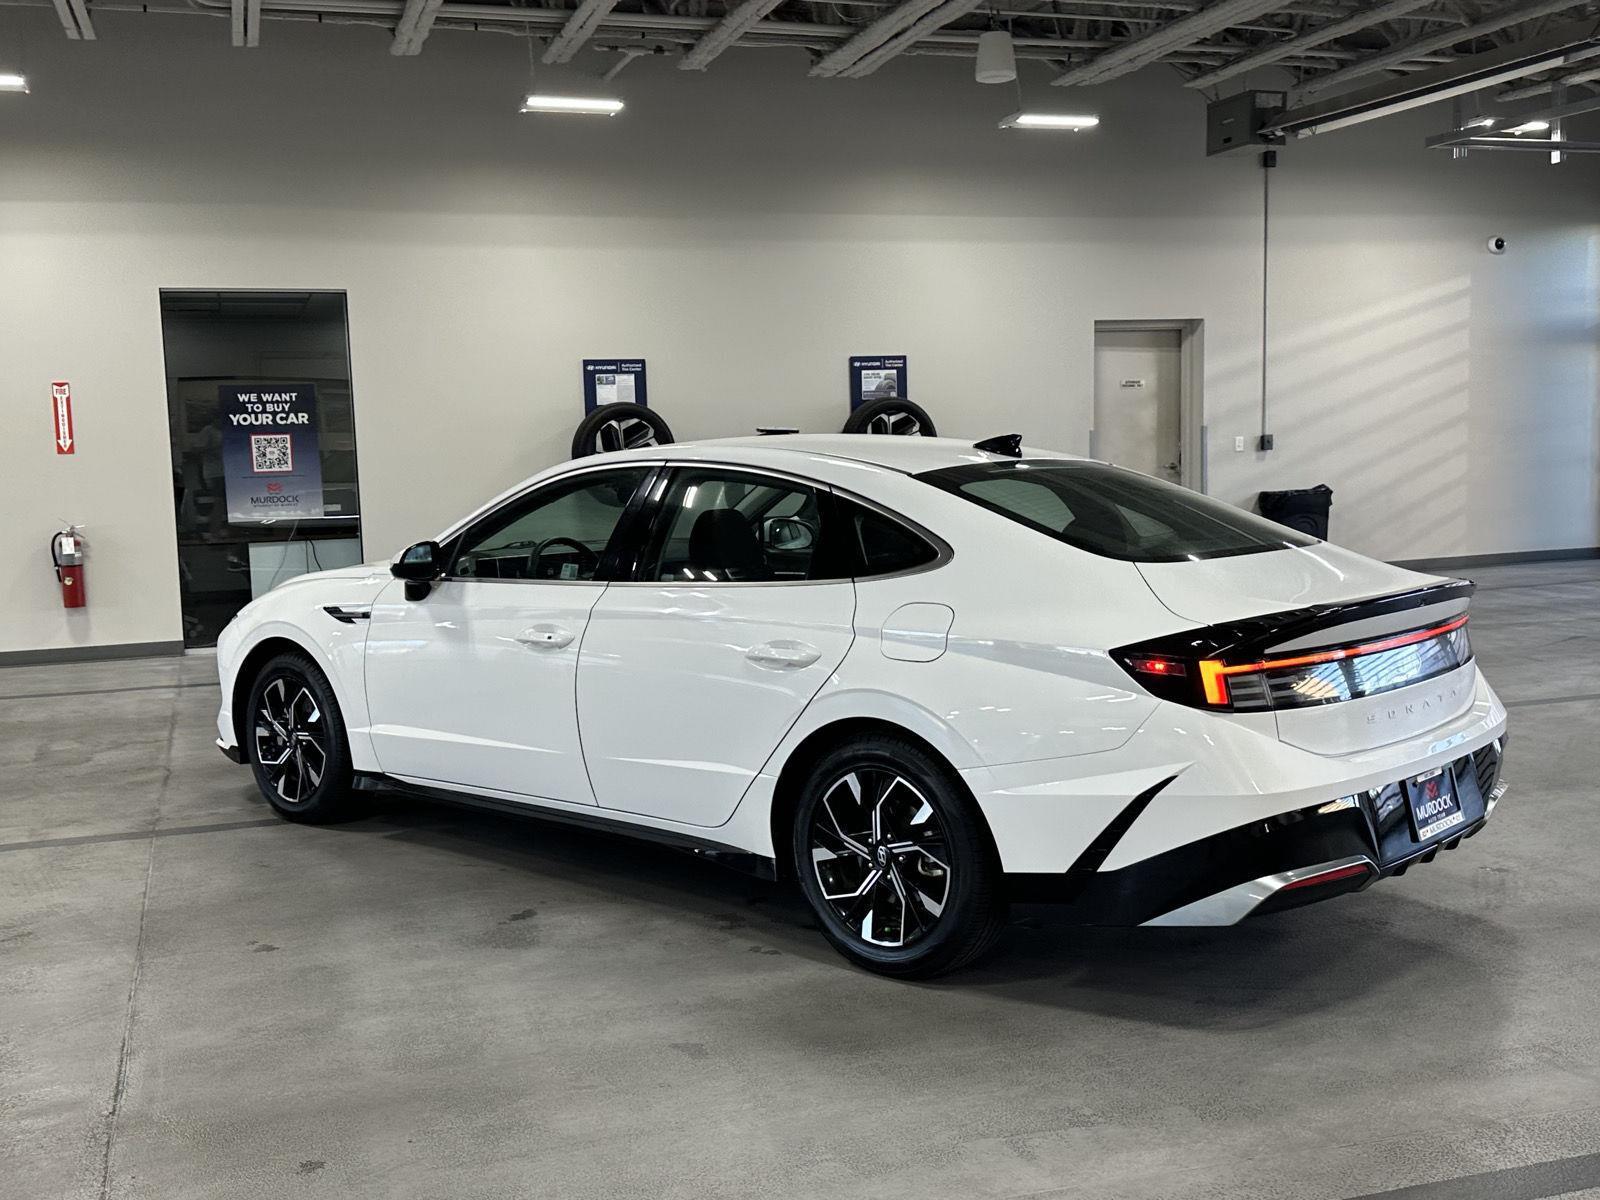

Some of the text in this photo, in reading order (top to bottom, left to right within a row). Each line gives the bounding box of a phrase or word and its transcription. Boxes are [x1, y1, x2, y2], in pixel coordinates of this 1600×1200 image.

[237, 392, 298, 402] WE WANT
[245, 402, 291, 412] TO BUY
[229, 412, 309, 426] YOUR CAR
[250, 494, 300, 505] MURDOCK
[1415, 793, 1453, 821] MURDOCK
